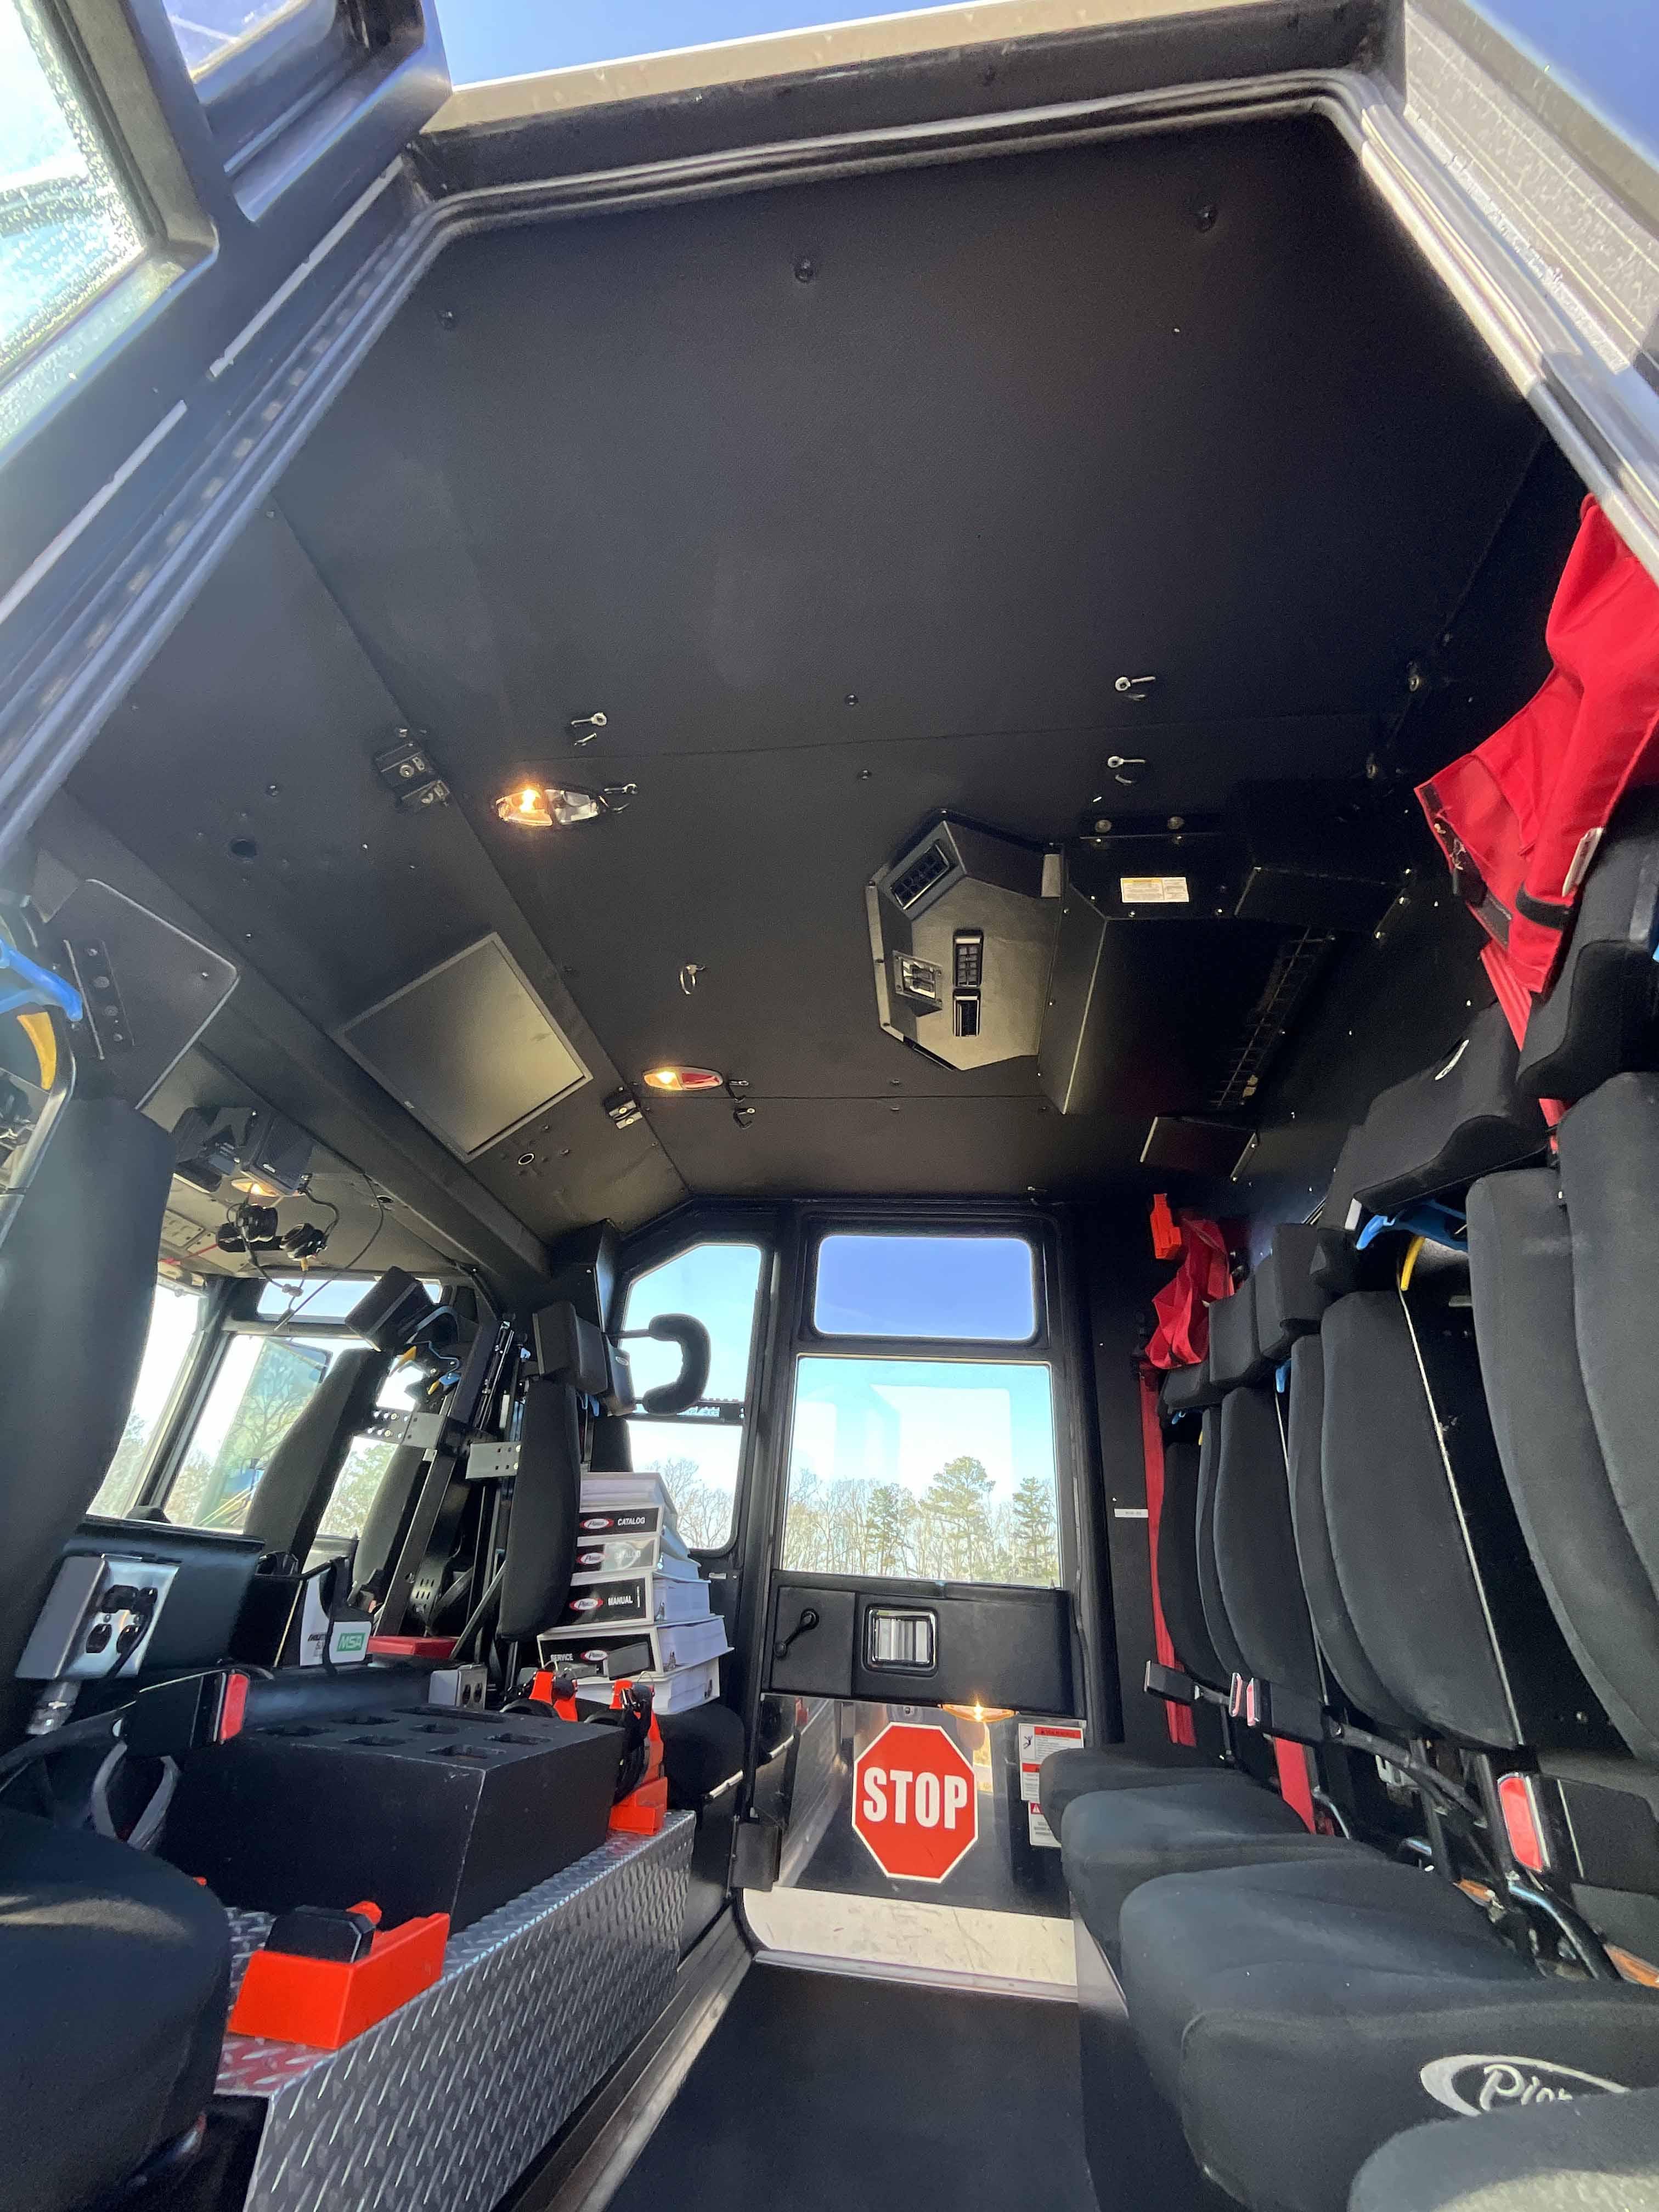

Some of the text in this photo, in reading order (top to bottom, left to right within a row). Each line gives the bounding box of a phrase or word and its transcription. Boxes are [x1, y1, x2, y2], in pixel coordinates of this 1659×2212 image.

[617, 1516, 645, 1526] CATALOG
[608, 1595, 633, 1606] MANUAL
[338, 1635, 363, 1650] MSA
[863, 1767, 967, 1830] STOP
